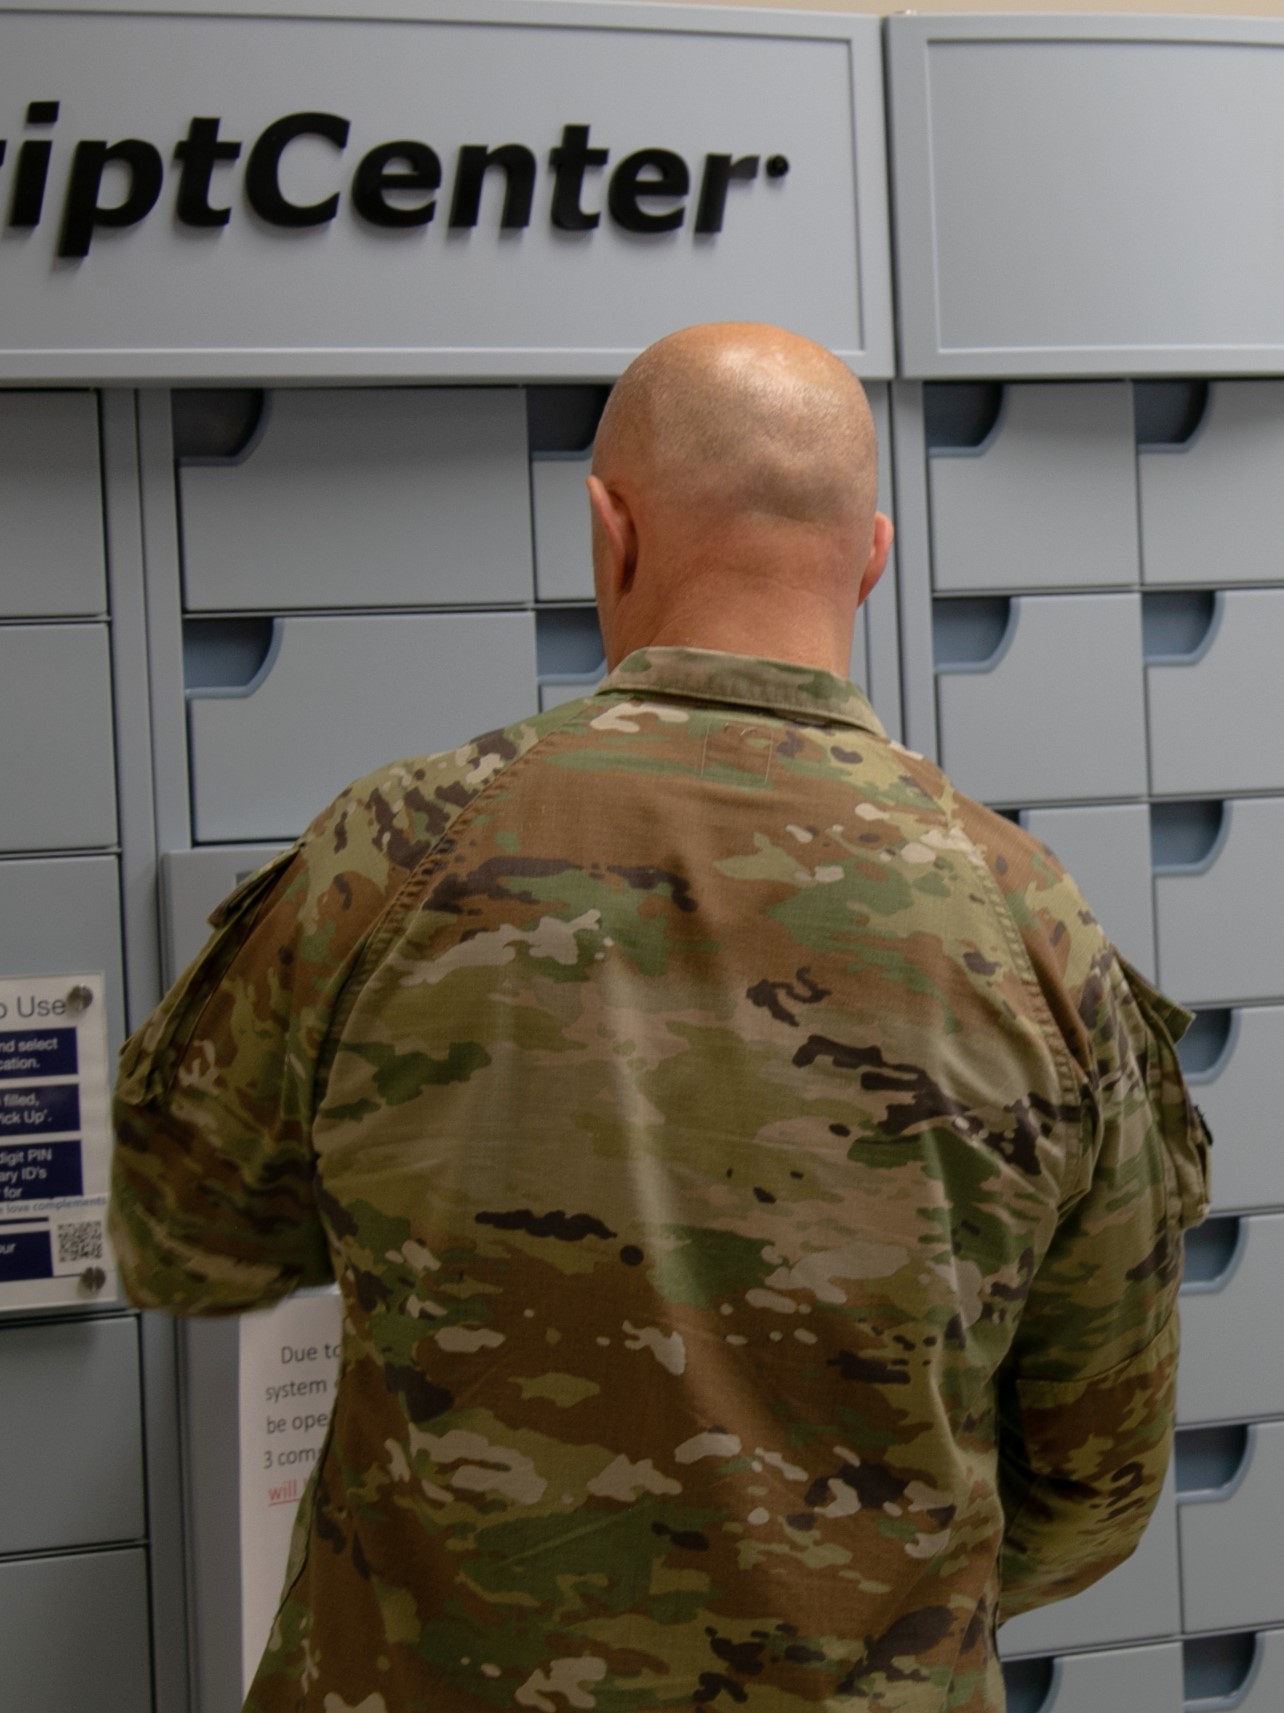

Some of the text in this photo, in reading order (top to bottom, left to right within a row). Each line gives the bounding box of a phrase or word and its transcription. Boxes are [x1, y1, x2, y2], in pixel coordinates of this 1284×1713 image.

[0, 100, 766, 258] iptCenter
[17, 995, 67, 1018] Use
[18, 1037, 59, 1052] select
[3, 1091, 41, 1108] filled,
[27, 1148, 53, 1162] PIN
[21, 1166, 48, 1181] ID's
[3, 1186, 24, 1199] for
[281, 1345, 318, 1364] Due
[265, 1379, 328, 1404] system
[266, 1412, 328, 1435] be ope
[264, 1447, 321, 1470] 3 com
[268, 1479, 297, 1501] will
